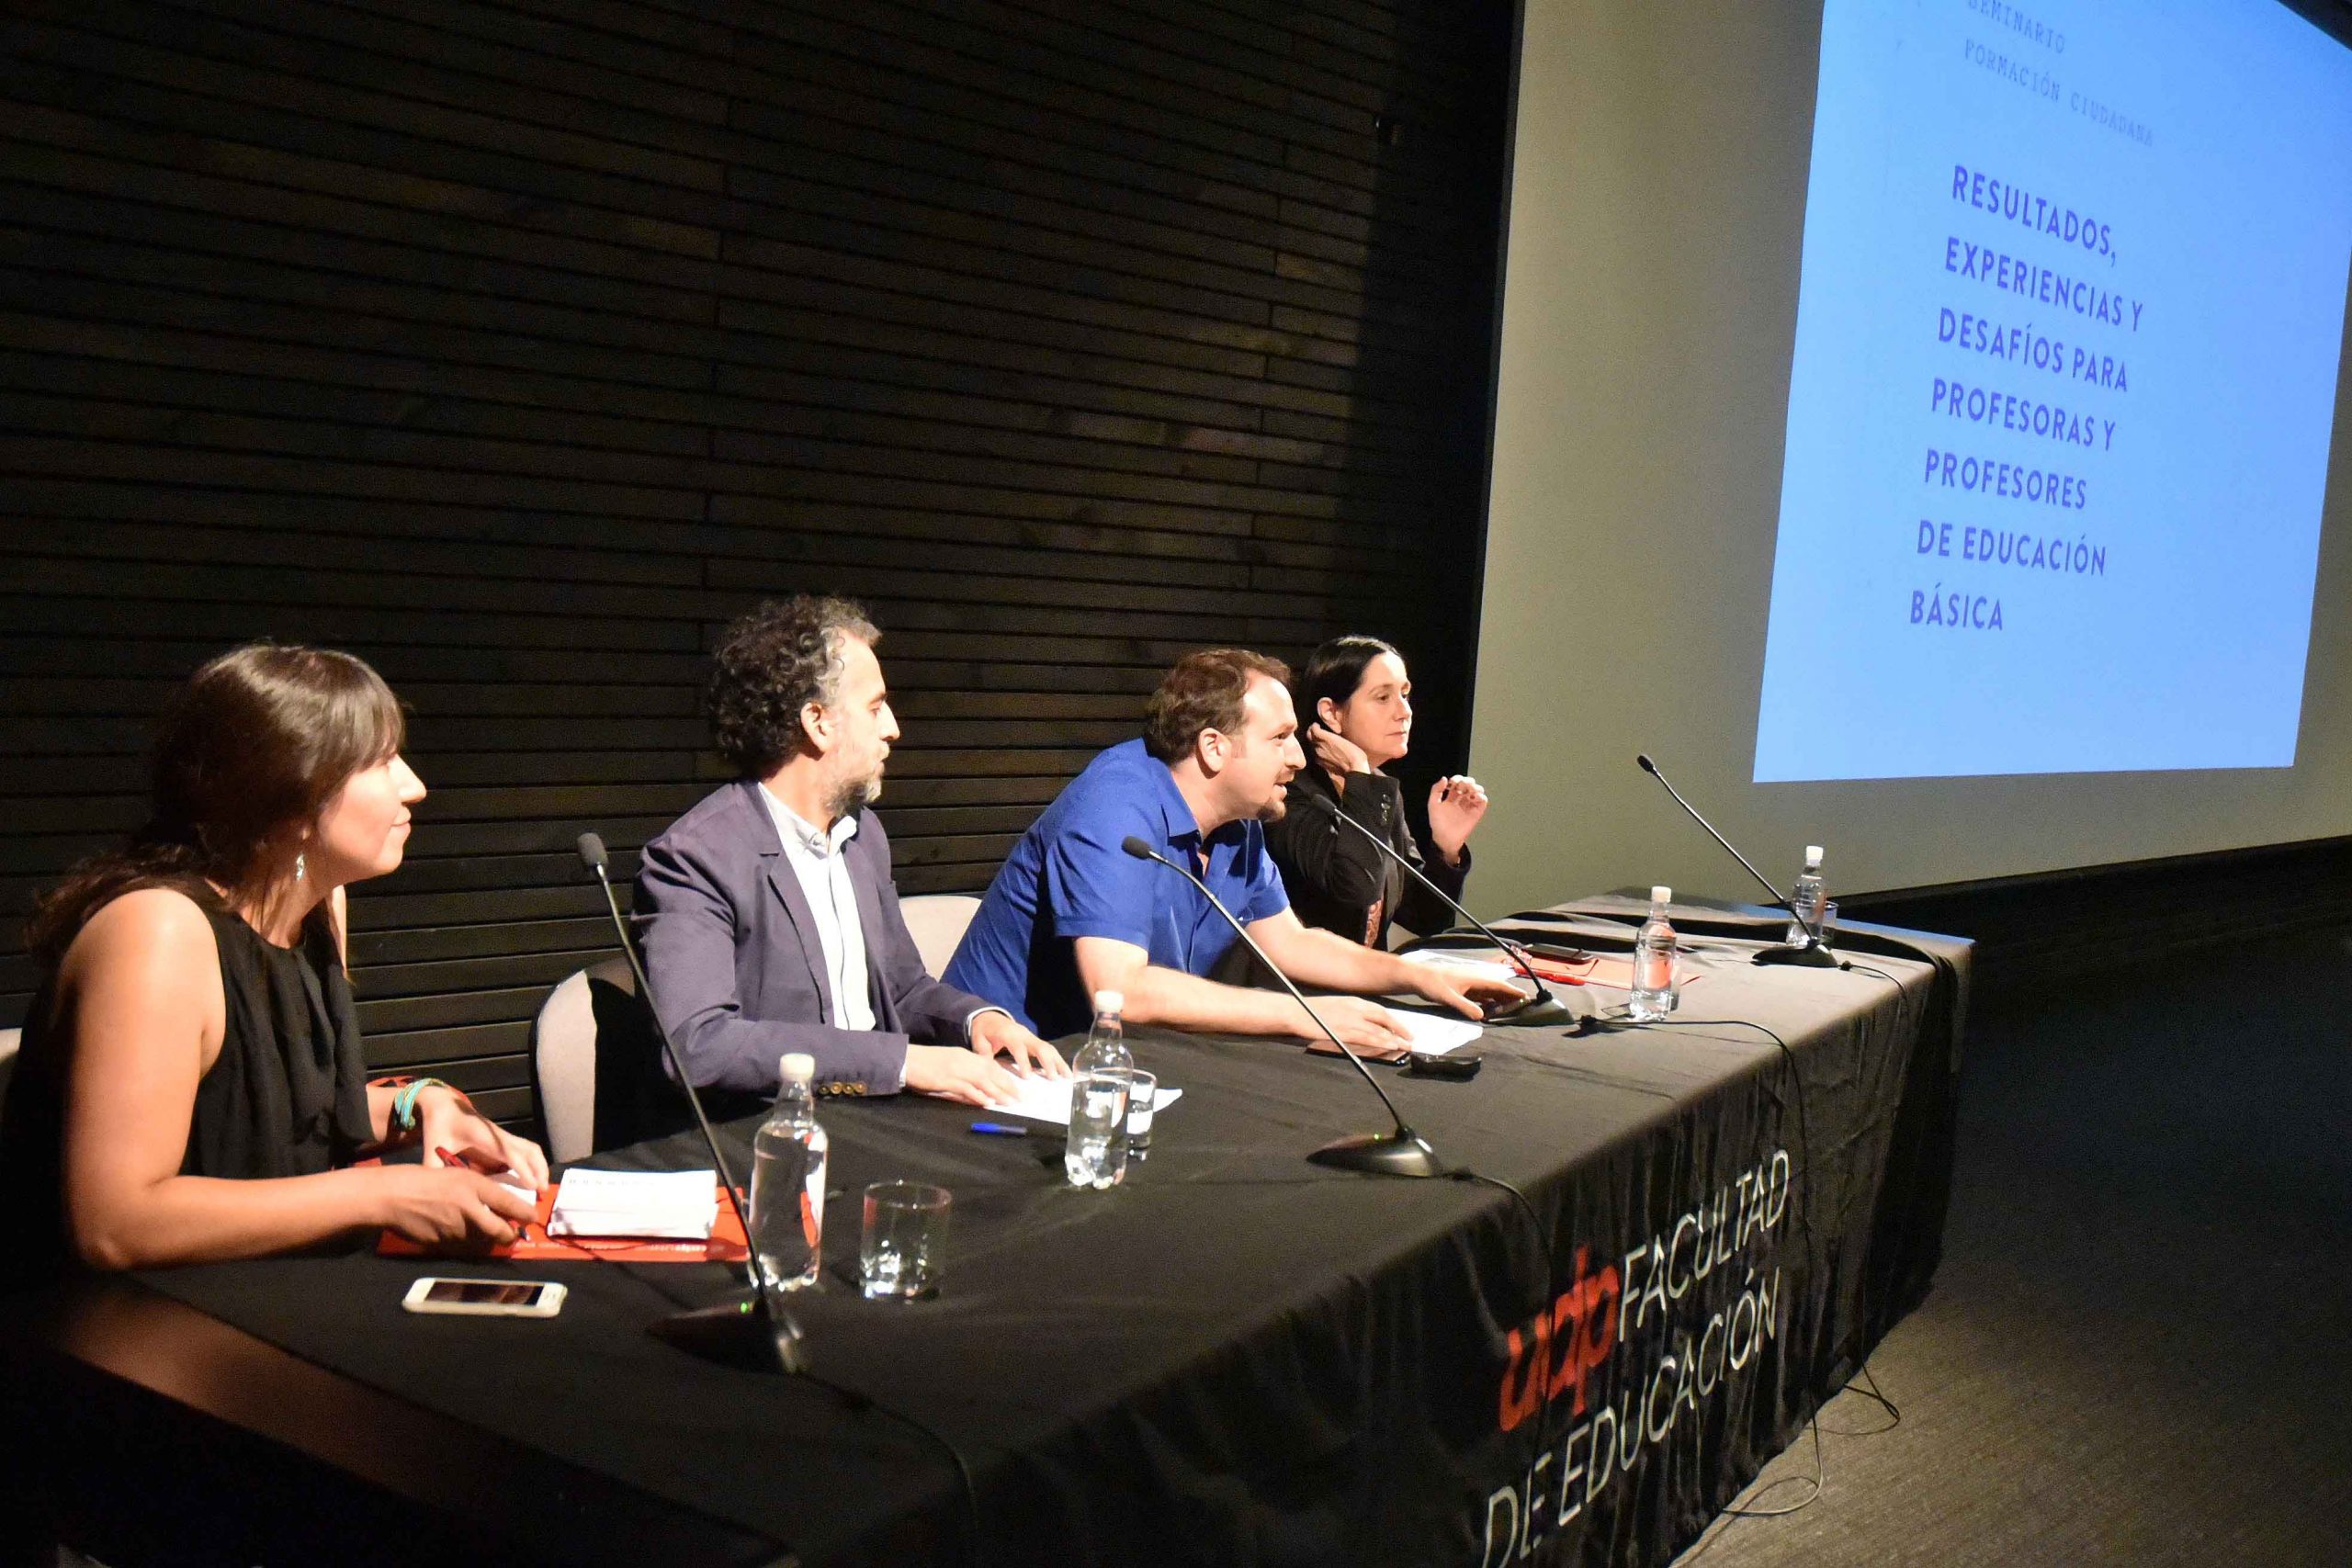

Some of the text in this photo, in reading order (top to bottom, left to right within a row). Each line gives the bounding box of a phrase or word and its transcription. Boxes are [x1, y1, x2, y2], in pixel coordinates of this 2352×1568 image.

[1965, 39, 2154, 147] FORMACIÓN CIUDADANA
[1952, 165, 2116, 266] RESULTADOS,
[1945, 236, 2143, 332] EXPERIENCIAS Y
[1939, 307, 2128, 392] DESAFÍOS PARA
[1932, 378, 2115, 452] PROFESORAS Y
[1925, 449, 2086, 510] PROFESORES
[1917, 519, 2106, 576] DE EDUCACIÓN
[1910, 583, 2003, 631] BÁSICA
[1618, 1149, 1789, 1342] FACULTAD
[1482, 1266, 1781, 1568] DE EDUCACIÓN
